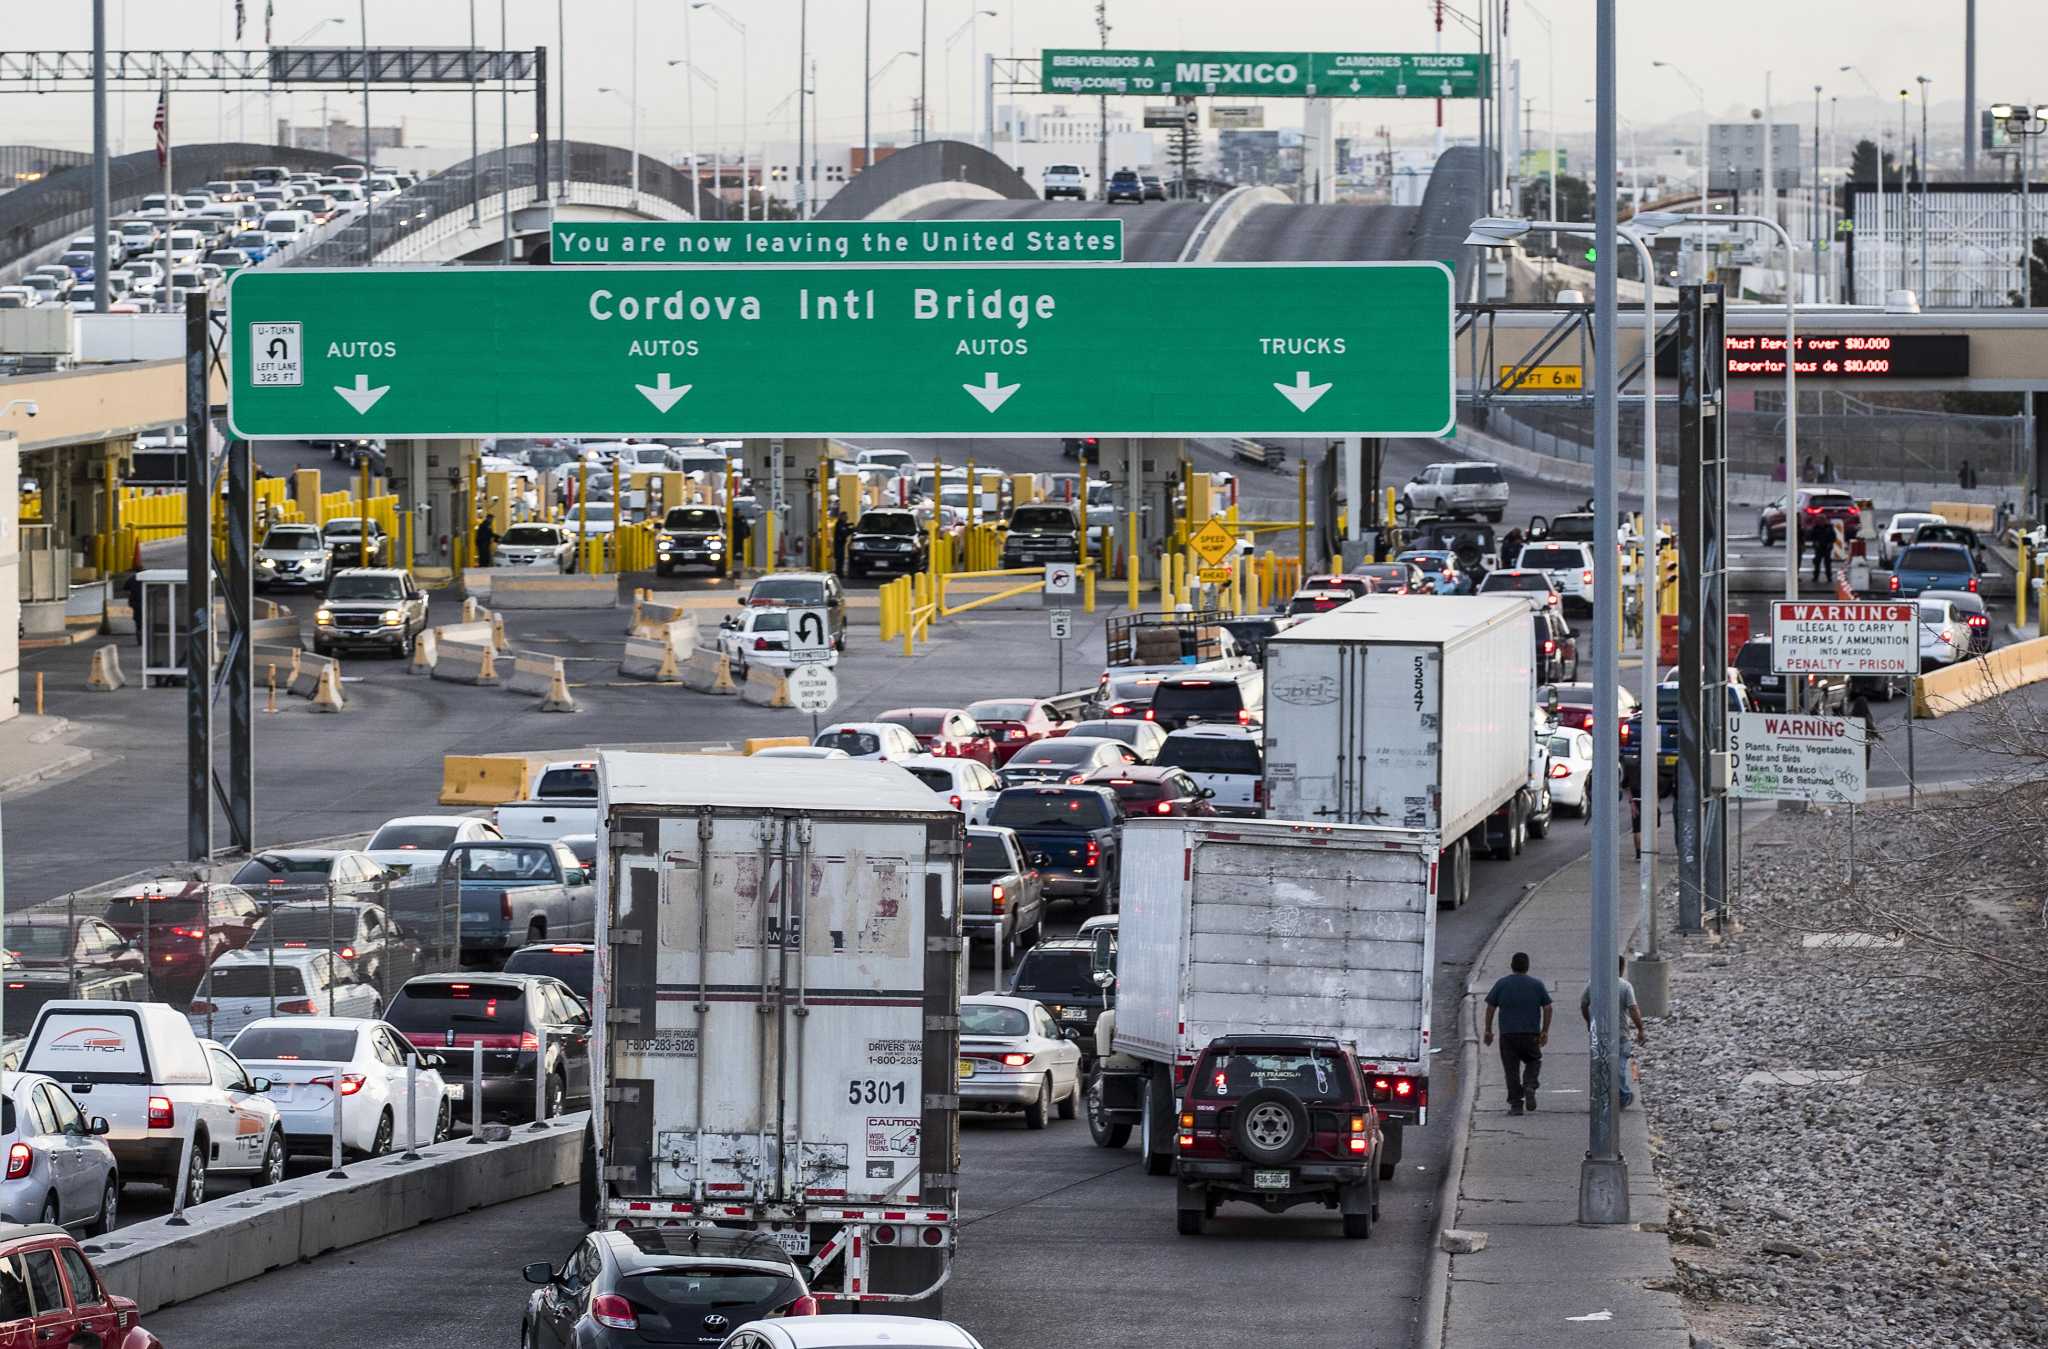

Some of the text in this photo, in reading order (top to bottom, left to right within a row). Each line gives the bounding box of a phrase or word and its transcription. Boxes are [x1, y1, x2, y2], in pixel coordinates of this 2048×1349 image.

[1052, 56, 1155, 67] BIENVENIDOS A
[1336, 57, 1401, 67] CAMIONES
[1411, 57, 1464, 67] TRUCKS
[1176, 62, 1298, 84] MEXICO
[1052, 77, 1154, 89] WELCOME TO
[559, 231, 1115, 258] You are now leaving the United States
[589, 288, 1056, 329] Cordova Intl Bridge
[257, 326, 295, 335] U-TURN
[327, 341, 397, 358] AUTOS
[628, 340, 699, 356] AUTOS
[956, 338, 1029, 355] AUTOS
[1259, 338, 1346, 354] TRUCKS
[1726, 337, 1890, 350] Must Repot over $10,000
[256, 362, 297, 371] LEFT LANE
[1728, 359, 1786, 372] Reportar
[1822, 359, 1838, 372] de
[1843, 359, 1888, 372] $10,000
[260, 373, 294, 382] 325 FT
[1528, 374, 1544, 384] FT
[1552, 371, 1562, 384] 6
[1564, 374, 1577, 384] IN
[1793, 605, 1899, 620] WARNING
[1056, 624, 1066, 637] 5
[1796, 622, 1894, 632] ILLEGAL TO CARRY
[1782, 635, 1909, 645] FIREARMS / AMMUNITION
[1820, 648, 1872, 656] INTO MEXICO
[1787, 658, 1842, 670] PENALTY
[1859, 658, 1905, 670] PRISON
[1413, 656, 1424, 712] 53547
[1765, 719, 1845, 737] WARNING
[1806, 744, 1855, 756] Vegetables,
[1745, 753, 1801, 763] Meat and Birds
[1746, 764, 1817, 774] Taken To Mexico
[1782, 776, 1794, 785] Be
[1797, 776, 1835, 786] Returned
[625, 1040, 695, 1051] 1-800-283-5126
[868, 1043, 905, 1051] DRIVERS
[848, 1080, 905, 1105] 5301
[868, 1119, 921, 1127] CAUTION
